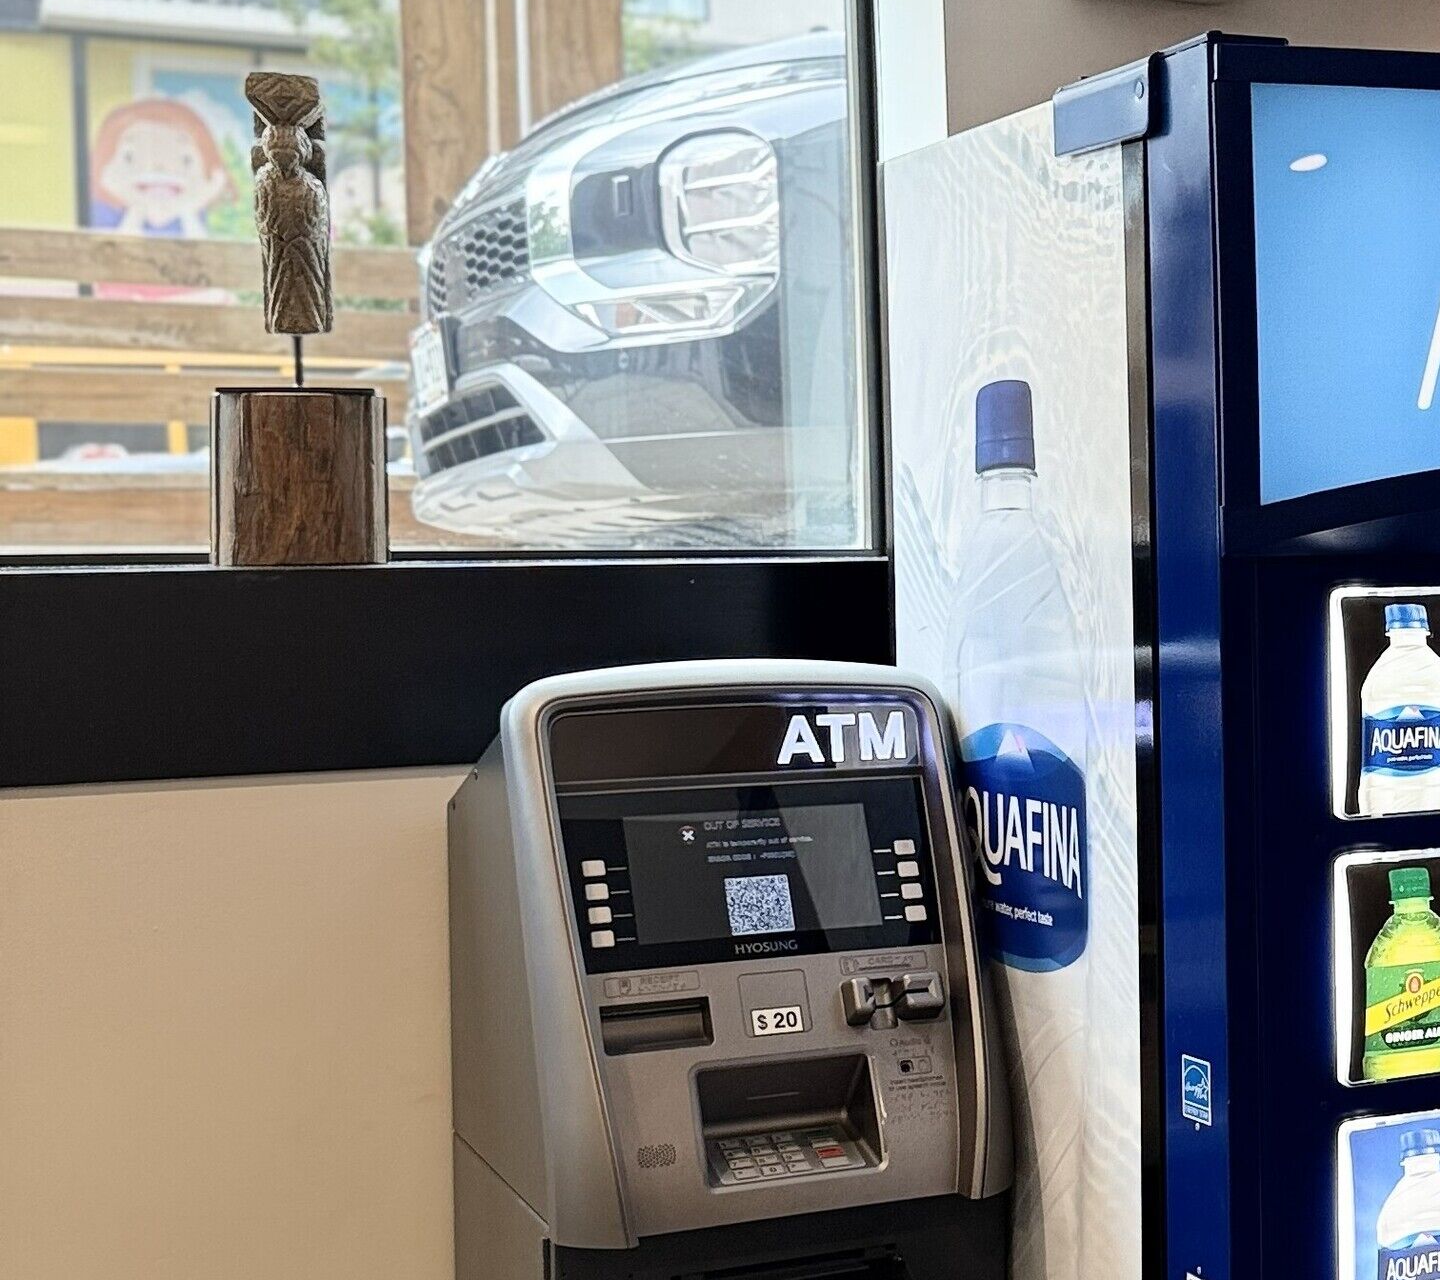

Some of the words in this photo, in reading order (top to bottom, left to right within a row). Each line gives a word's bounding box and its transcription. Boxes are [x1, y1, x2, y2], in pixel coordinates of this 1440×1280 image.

[777, 712, 908, 765] ATM
[703, 820, 724, 831] OUT
[726, 819, 738, 830] OF
[741, 817, 781, 828] SERVICE
[963, 784, 1082, 899] QUAFINA
[735, 939, 798, 955] HYOSUNG
[757, 1014, 769, 1030] $
[773, 1010, 798, 1029] 20
[1385, 1029, 1425, 1044] GINGER
